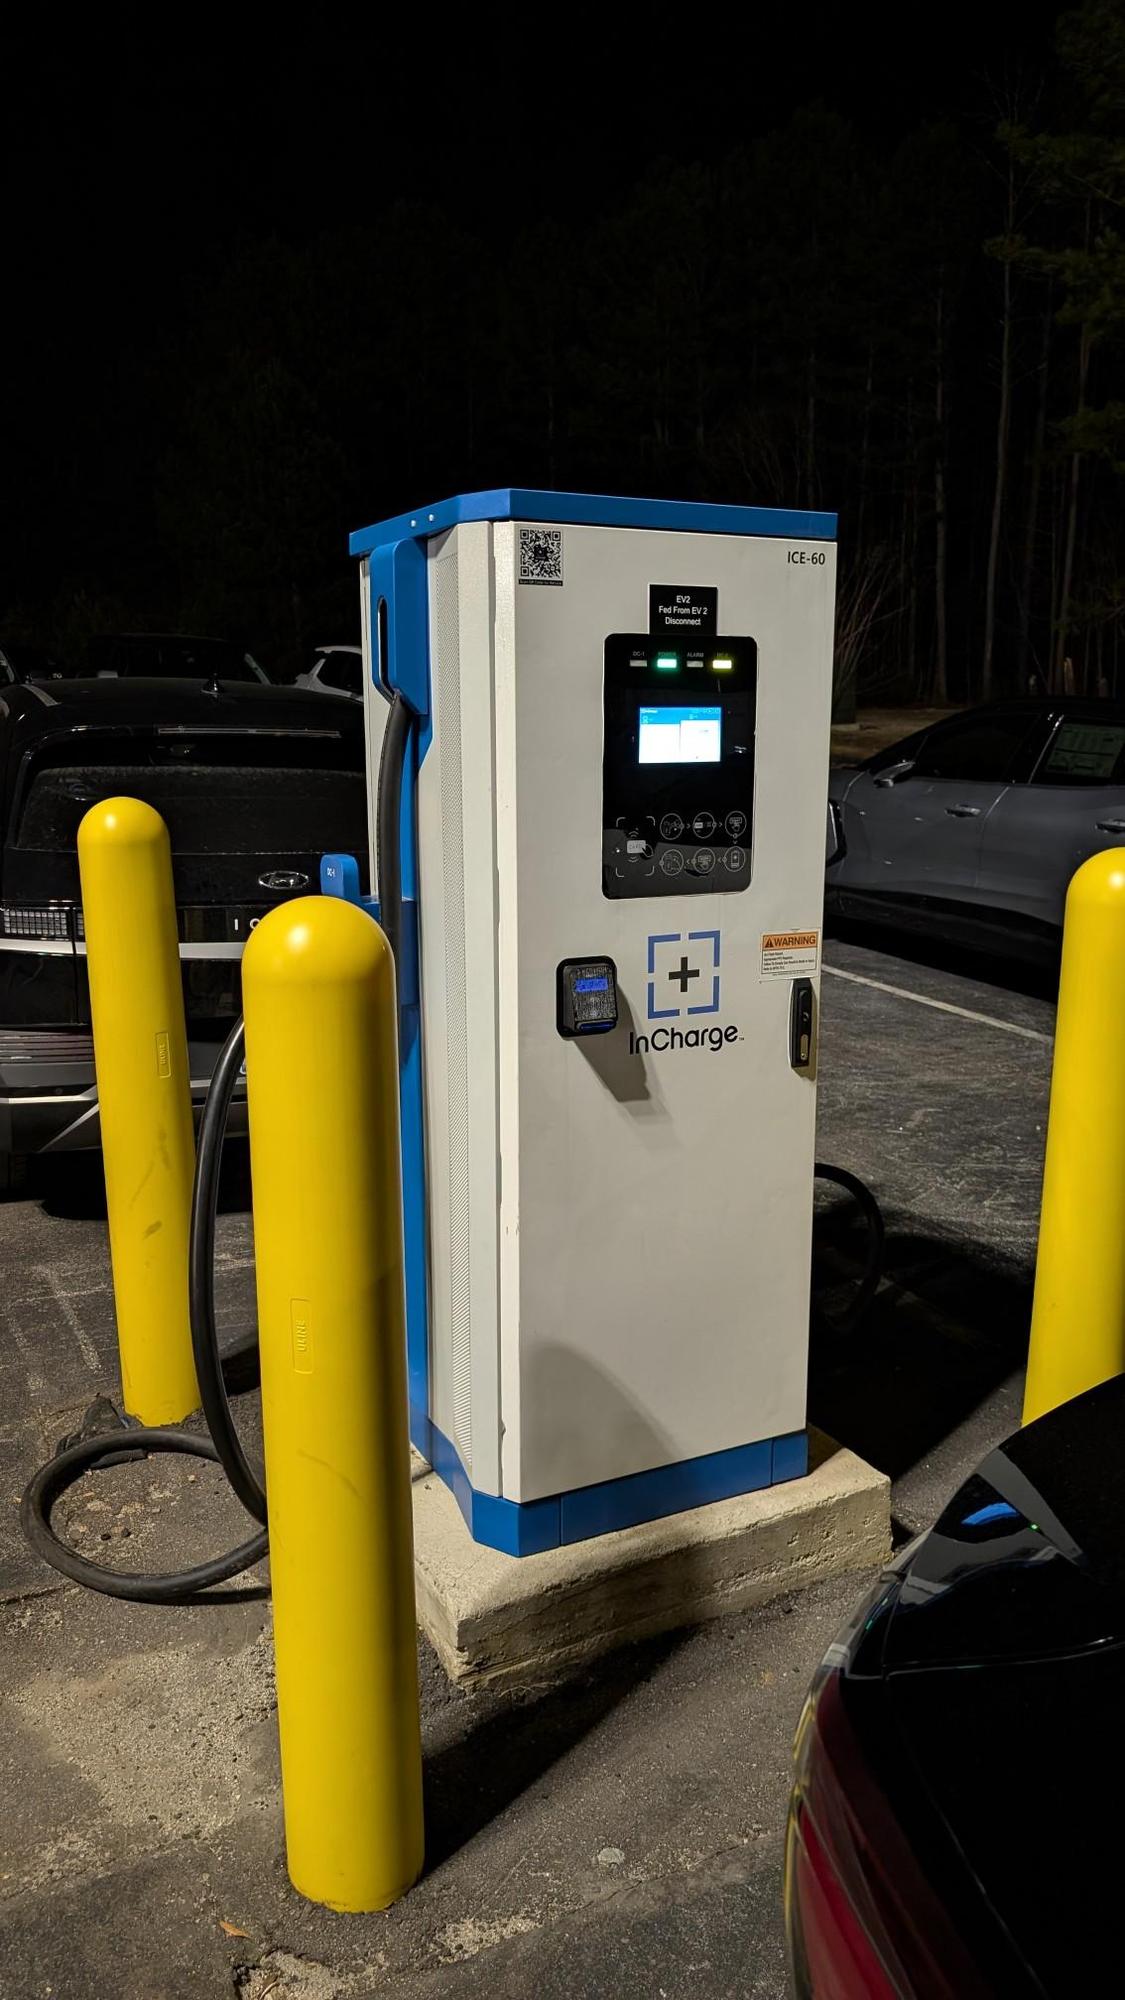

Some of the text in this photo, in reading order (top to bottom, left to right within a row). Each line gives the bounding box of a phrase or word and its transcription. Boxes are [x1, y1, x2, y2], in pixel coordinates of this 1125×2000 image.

[787, 551, 826, 565] ICE-60
[676, 595, 691, 604] EV2
[658, 605, 672, 614] Fed
[673, 606, 690, 615] From
[691, 606, 702, 615] EV
[665, 616, 701, 626] Disconnect
[773, 935, 816, 947] WARNING
[629, 1025, 738, 1055] InCharge
